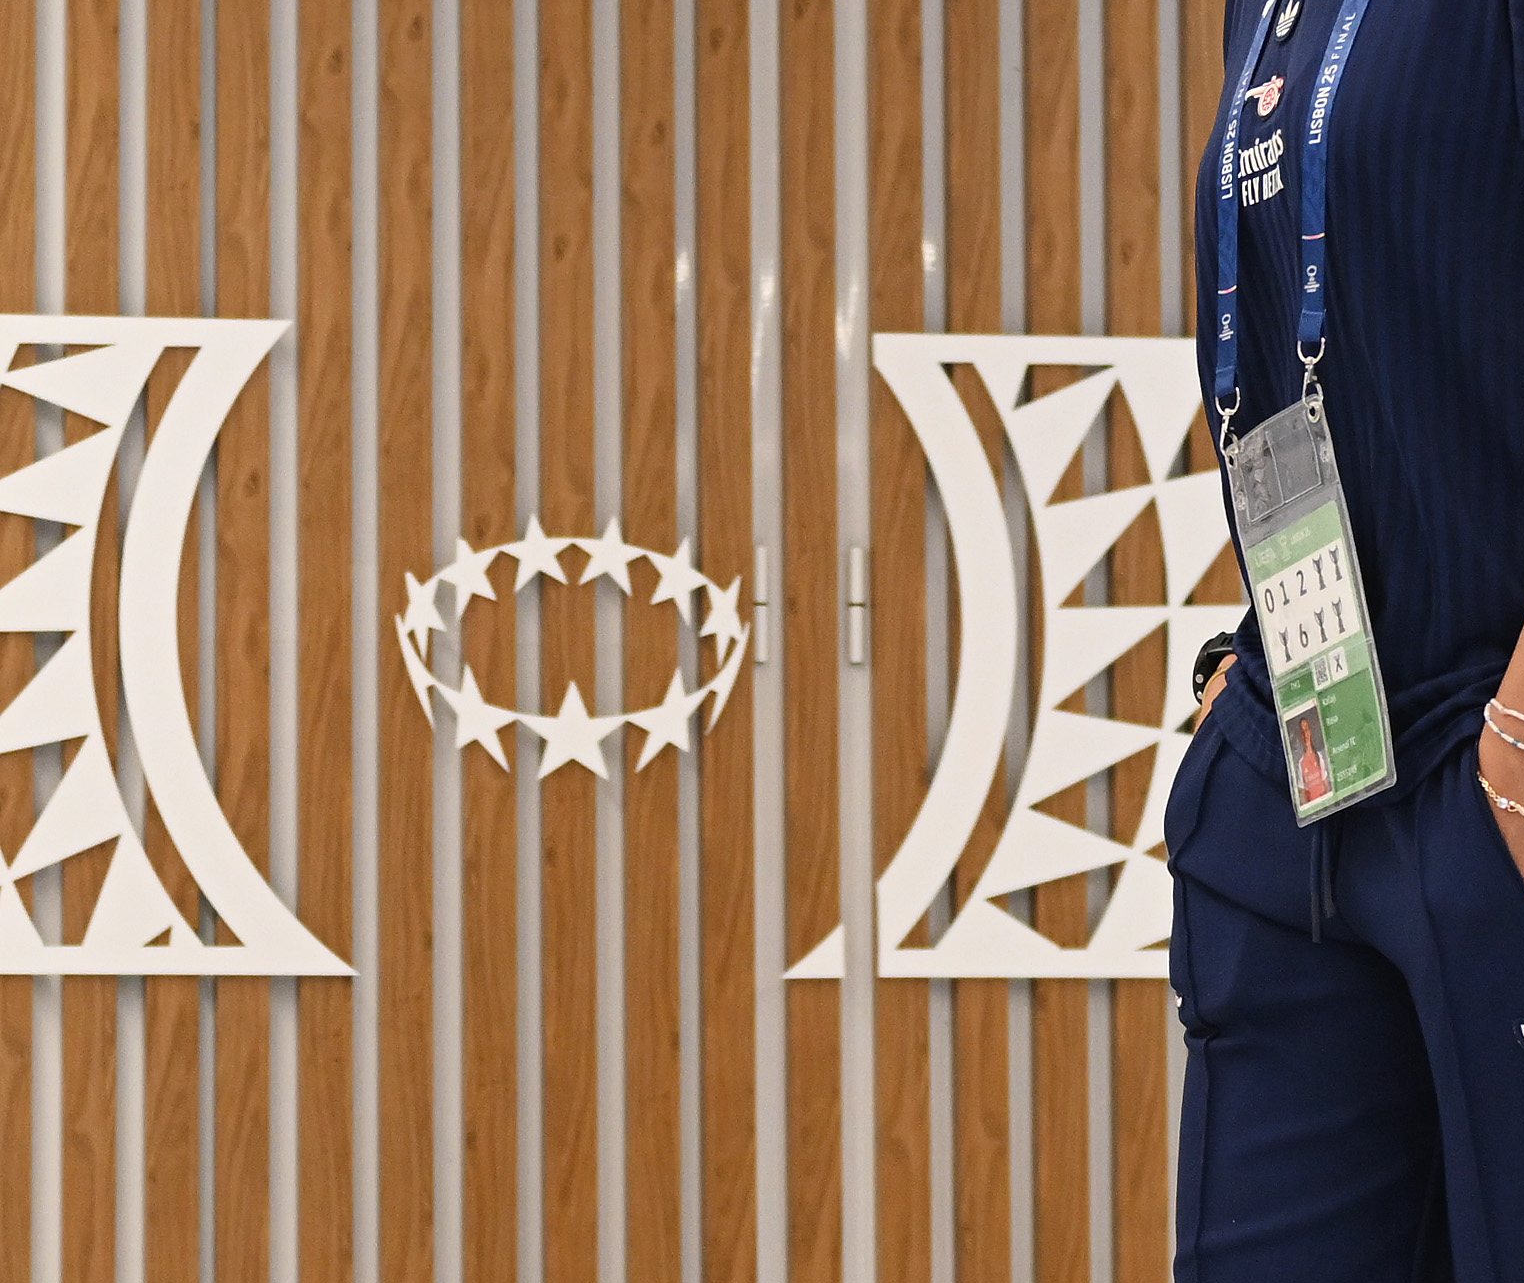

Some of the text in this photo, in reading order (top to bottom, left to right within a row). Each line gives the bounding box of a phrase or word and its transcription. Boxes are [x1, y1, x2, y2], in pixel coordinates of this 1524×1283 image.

[1308, 13, 1357, 144] LISBON 25 FINAL
[1226, 119, 1238, 140] 25
[1221, 142, 1235, 200] LISBON
[1241, 176, 1260, 207] FLY
[1299, 623, 1309, 648] 6
